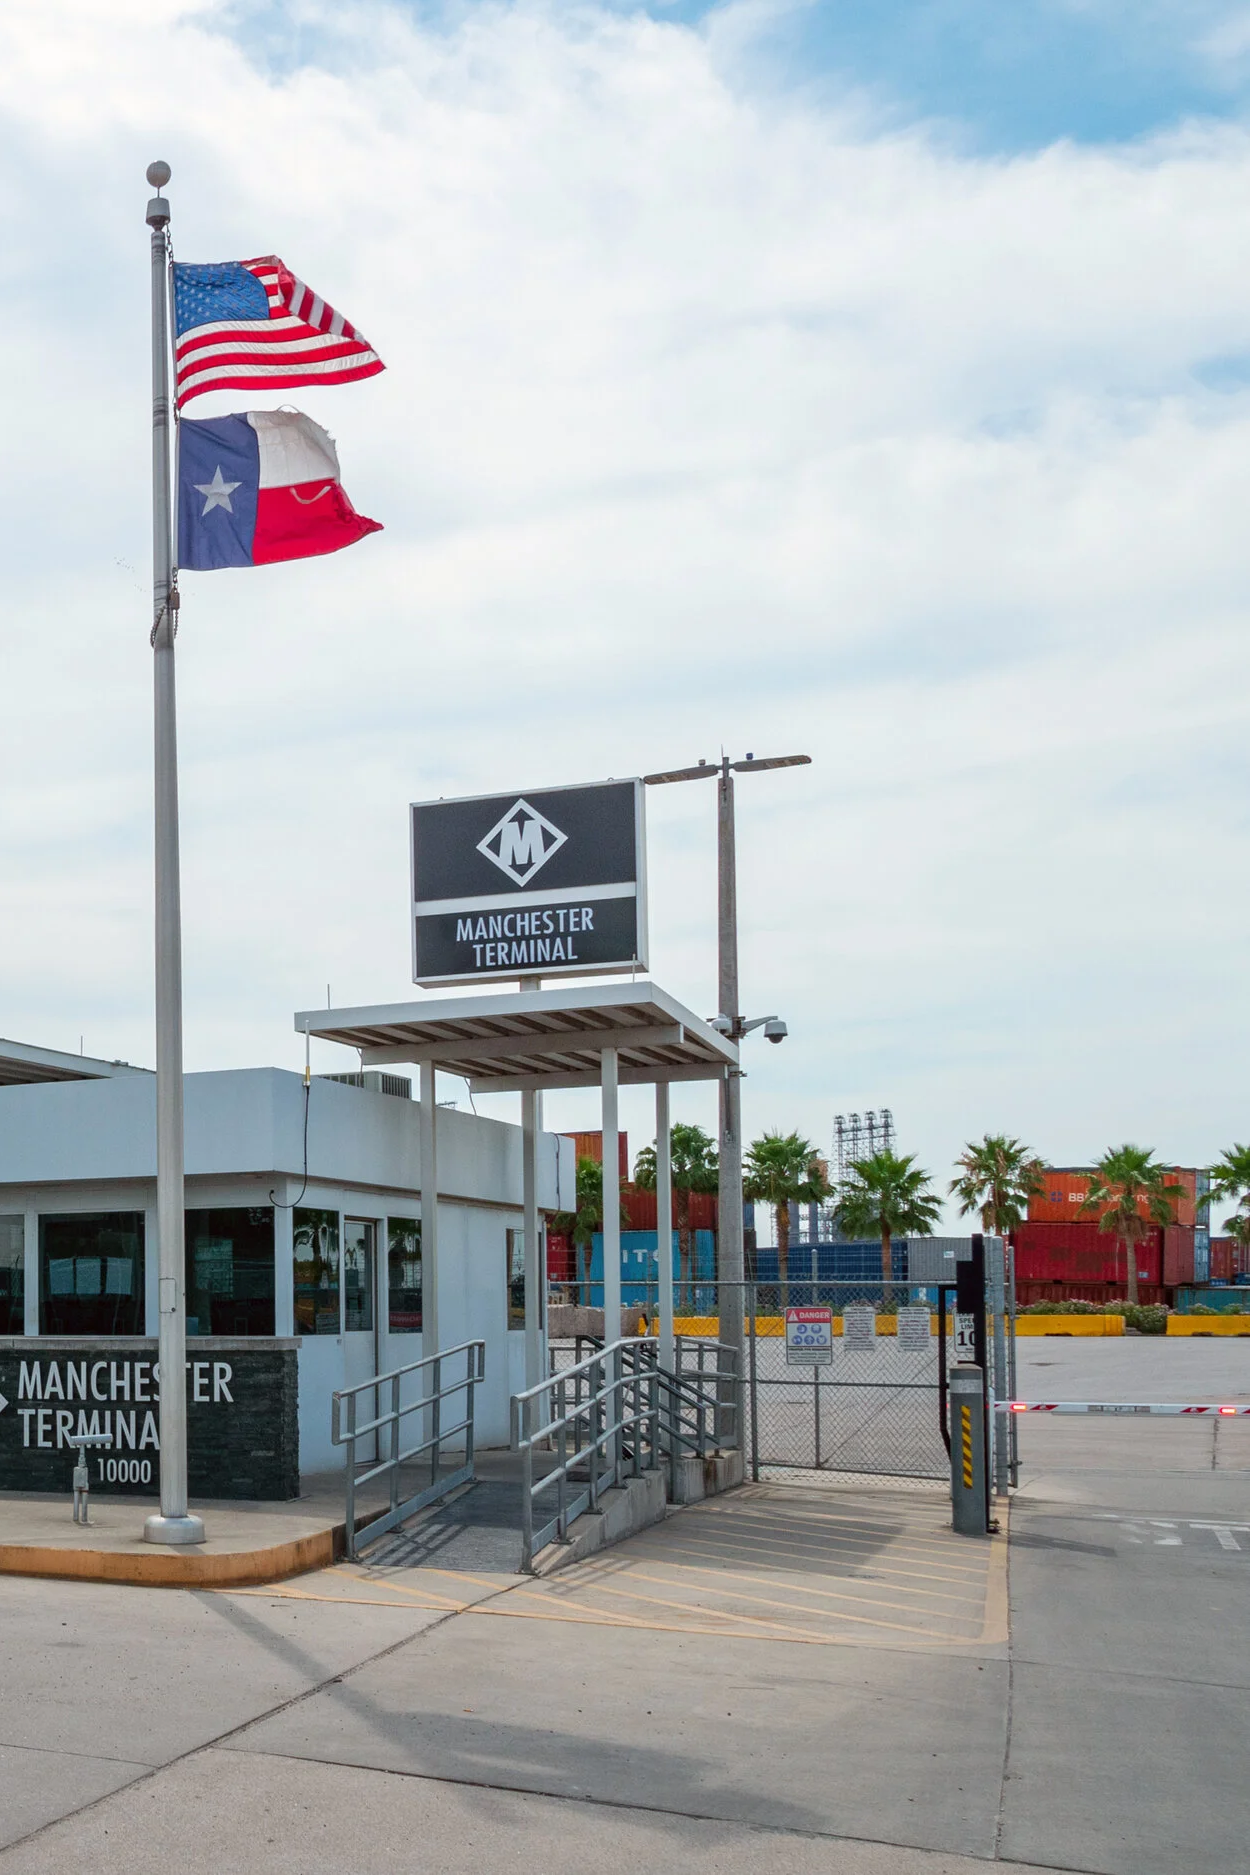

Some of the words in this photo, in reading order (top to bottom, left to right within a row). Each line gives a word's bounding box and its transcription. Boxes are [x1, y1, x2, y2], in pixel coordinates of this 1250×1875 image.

[456, 907, 594, 942] MANCHESTER
[472, 936, 578, 968] TERMINAL
[799, 1311, 830, 1319] DANGER
[957, 1330, 977, 1346] 10
[17, 1360, 234, 1403] MANCHEER
[17, 1409, 161, 1450] TERMINA
[97, 1458, 152, 1484] 10000
